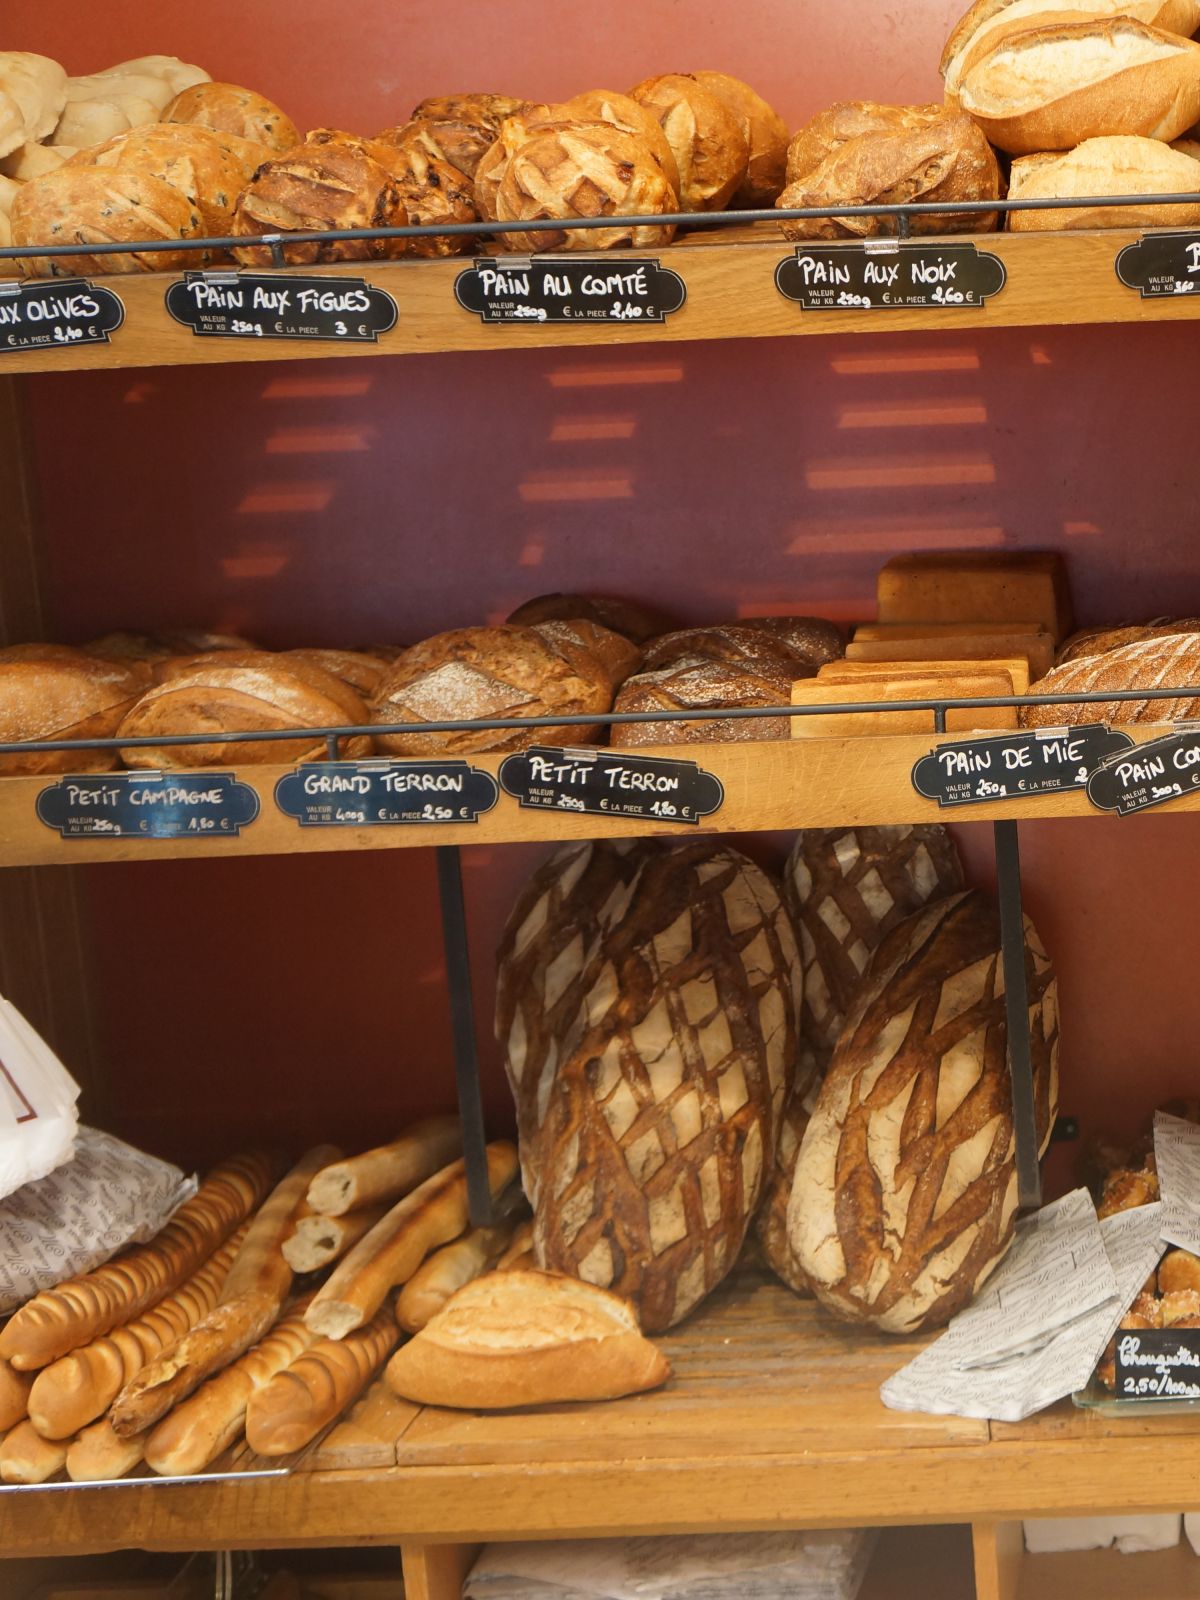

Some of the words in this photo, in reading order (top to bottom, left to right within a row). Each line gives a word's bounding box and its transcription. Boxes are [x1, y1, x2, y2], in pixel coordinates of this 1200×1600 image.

[543, 274, 572, 296] AU
[581, 267, 648, 295] COMTÉ
[864, 262, 899, 286] AUX
[1149, 276, 1175, 284] VALEUR
[253, 287, 291, 315] AUX
[883, 292, 890, 303] €
[931, 287, 964, 304] 2,60
[965, 291, 974, 302] €
[0, 302, 22, 324] UX
[563, 307, 571, 317] €
[609, 301, 642, 319] 2,40
[646, 307, 654, 317] €
[8, 335, 16, 345] €
[88, 326, 97, 336] €
[274, 322, 283, 333] €
[335, 322, 347, 335] 3
[358, 325, 367, 335] €
[1002, 746, 1032, 770] DE
[304, 774, 371, 795] GRAND
[380, 772, 463, 793] TERRON
[604, 767, 679, 792] TERRON
[946, 783, 971, 792] VALEUR
[1018, 780, 1026, 791] €
[1042, 779, 1061, 788] PIECE
[129, 787, 223, 806] CAMPAGNE
[529, 788, 554, 797] VALEUR
[1122, 788, 1147, 801] VALEUR
[1126, 801, 1136, 809] AU
[1192, 774, 1200, 784] €
[378, 808, 387, 818] €
[460, 807, 468, 818] €
[600, 799, 608, 809] €
[623, 805, 642, 813] PIECE
[682, 806, 691, 817] €
[68, 817, 93, 825] VALEUR
[140, 820, 147, 831] €
[221, 819, 228, 829] €
